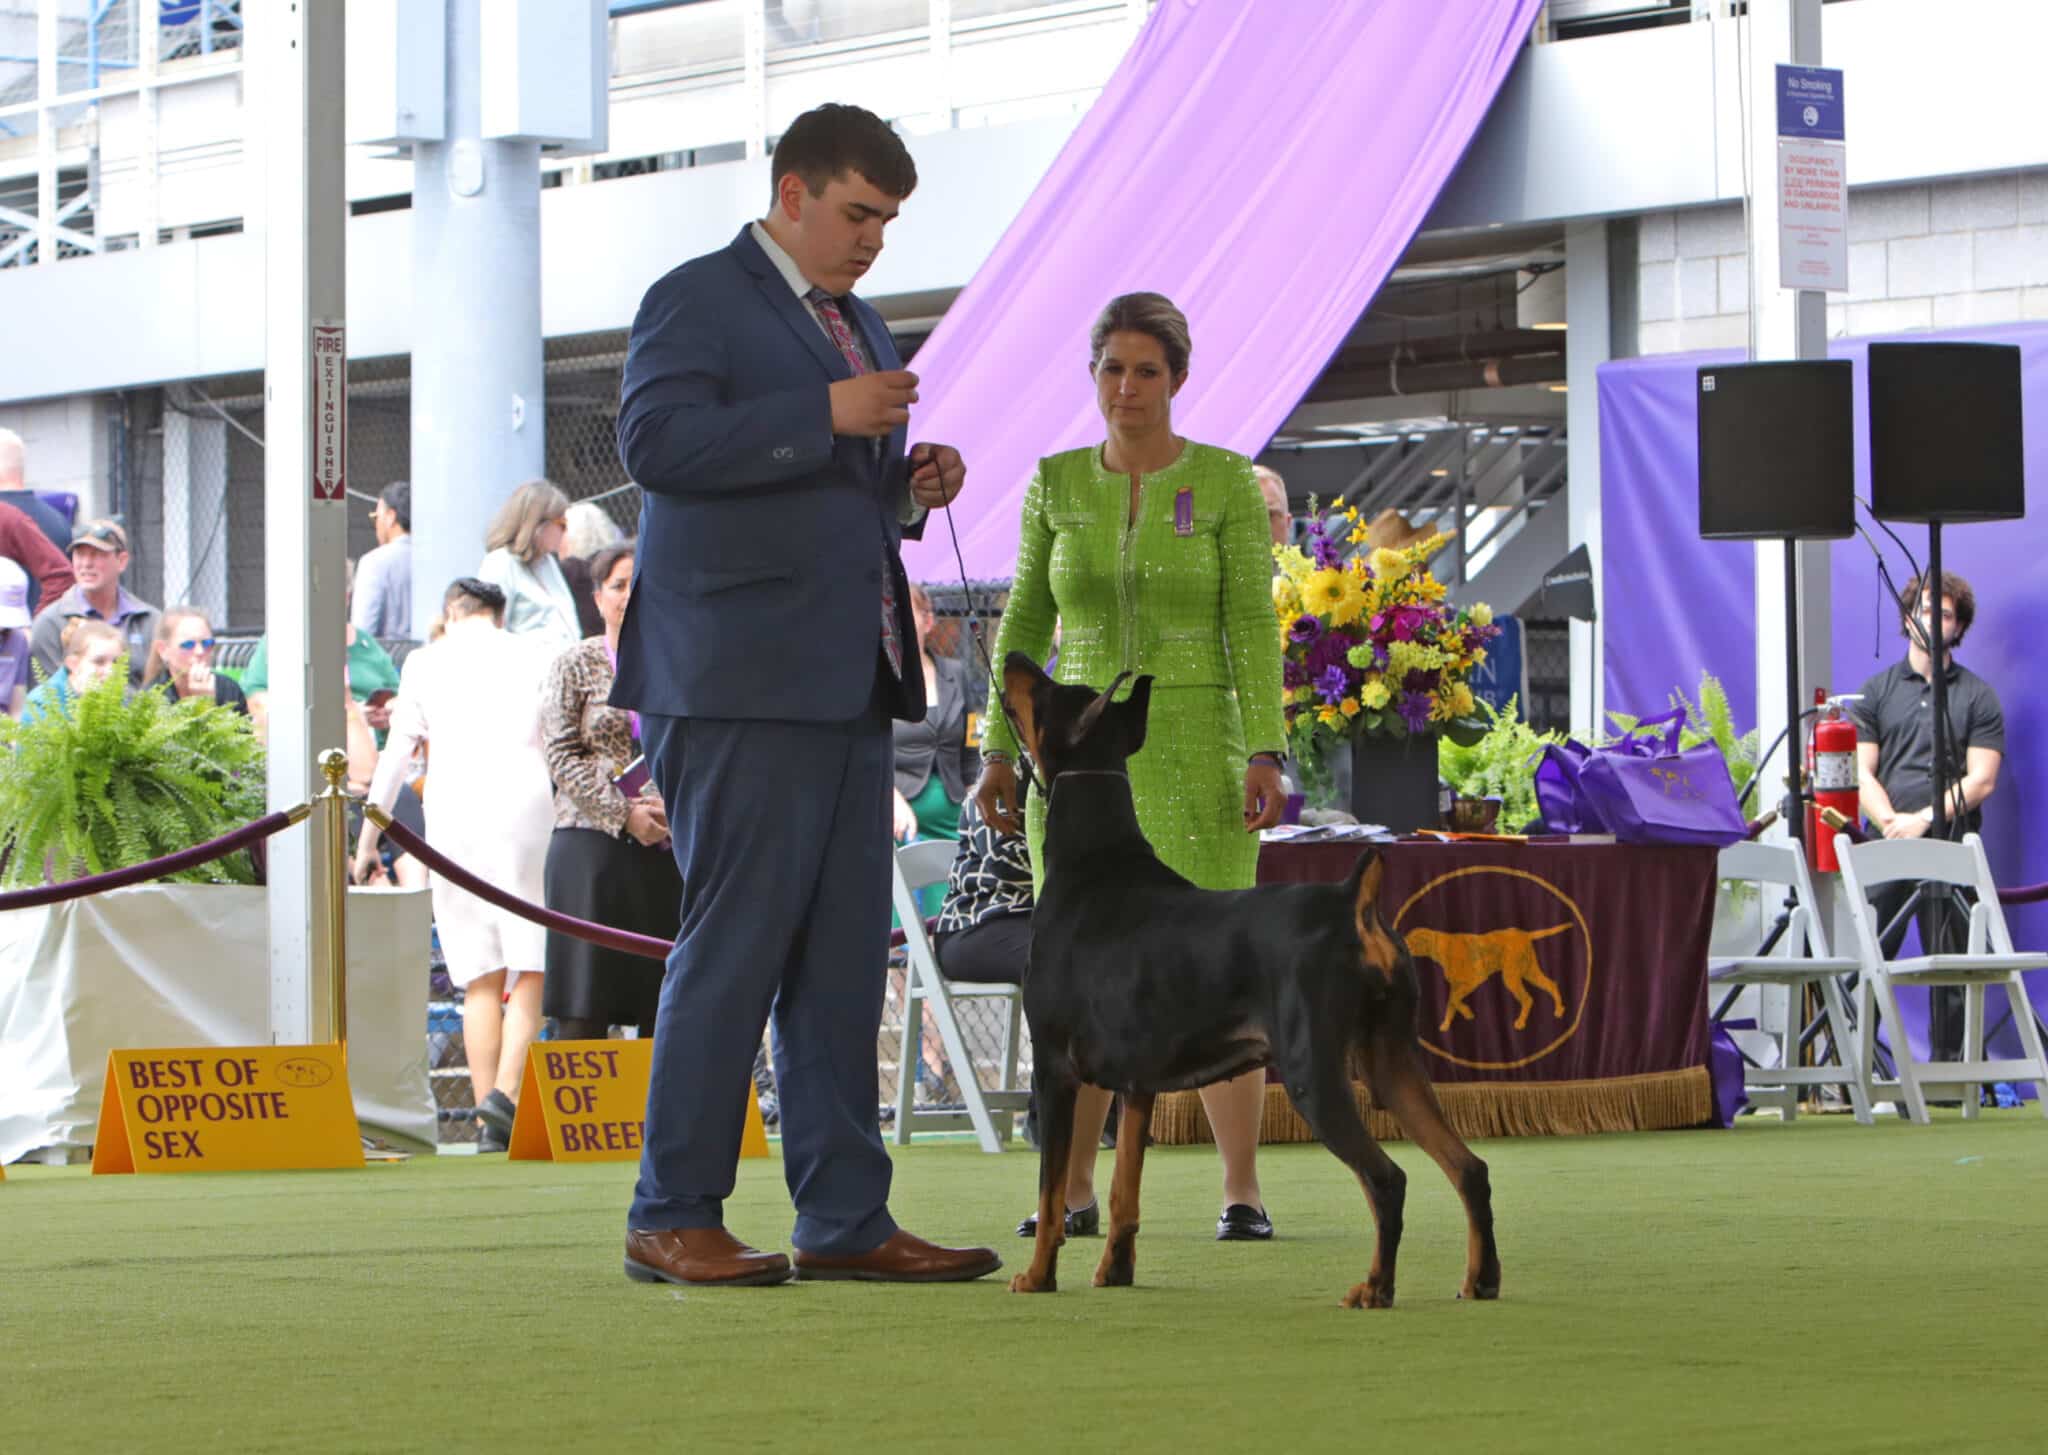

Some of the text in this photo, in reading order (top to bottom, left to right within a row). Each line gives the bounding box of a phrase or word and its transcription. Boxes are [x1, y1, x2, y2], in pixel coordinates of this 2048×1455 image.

[1788, 77, 1832, 94] No Smoking
[316, 337, 342, 353] FIRE
[324, 356, 334, 490] EXTINGUISHER
[128, 1058, 260, 1089] BEST OF
[544, 1050, 619, 1080] BEST
[137, 1091, 289, 1123] OPPOSITE
[554, 1085, 598, 1115] OF
[144, 1130, 204, 1160] SEX
